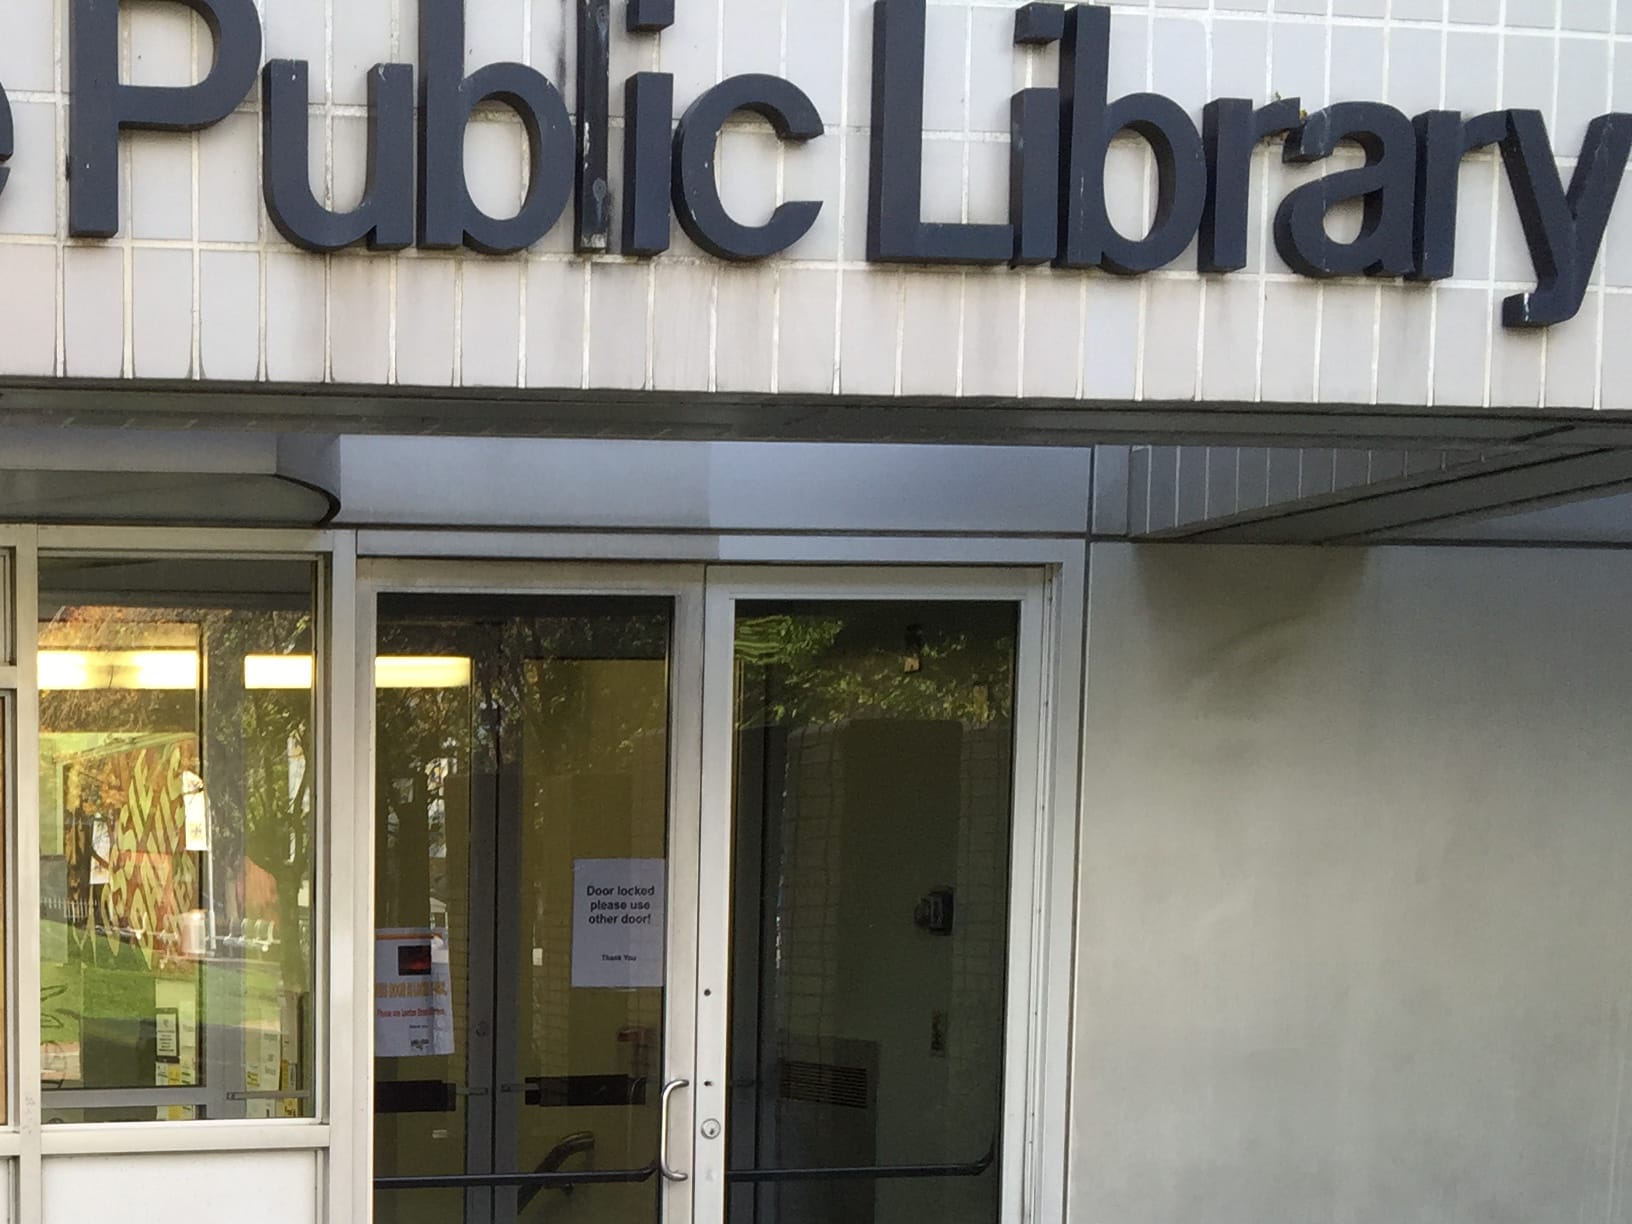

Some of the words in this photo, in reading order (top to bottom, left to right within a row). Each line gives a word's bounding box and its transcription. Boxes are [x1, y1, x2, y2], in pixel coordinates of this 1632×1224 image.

[68, 0, 823, 264] Public
[866, 0, 1632, 328] Library
[586, 885, 614, 896] Door
[617, 885, 655, 896] locked
[590, 900, 627, 912] please
[629, 901, 650, 911] use
[588, 914, 618, 924] other
[620, 914, 651, 924] door!
